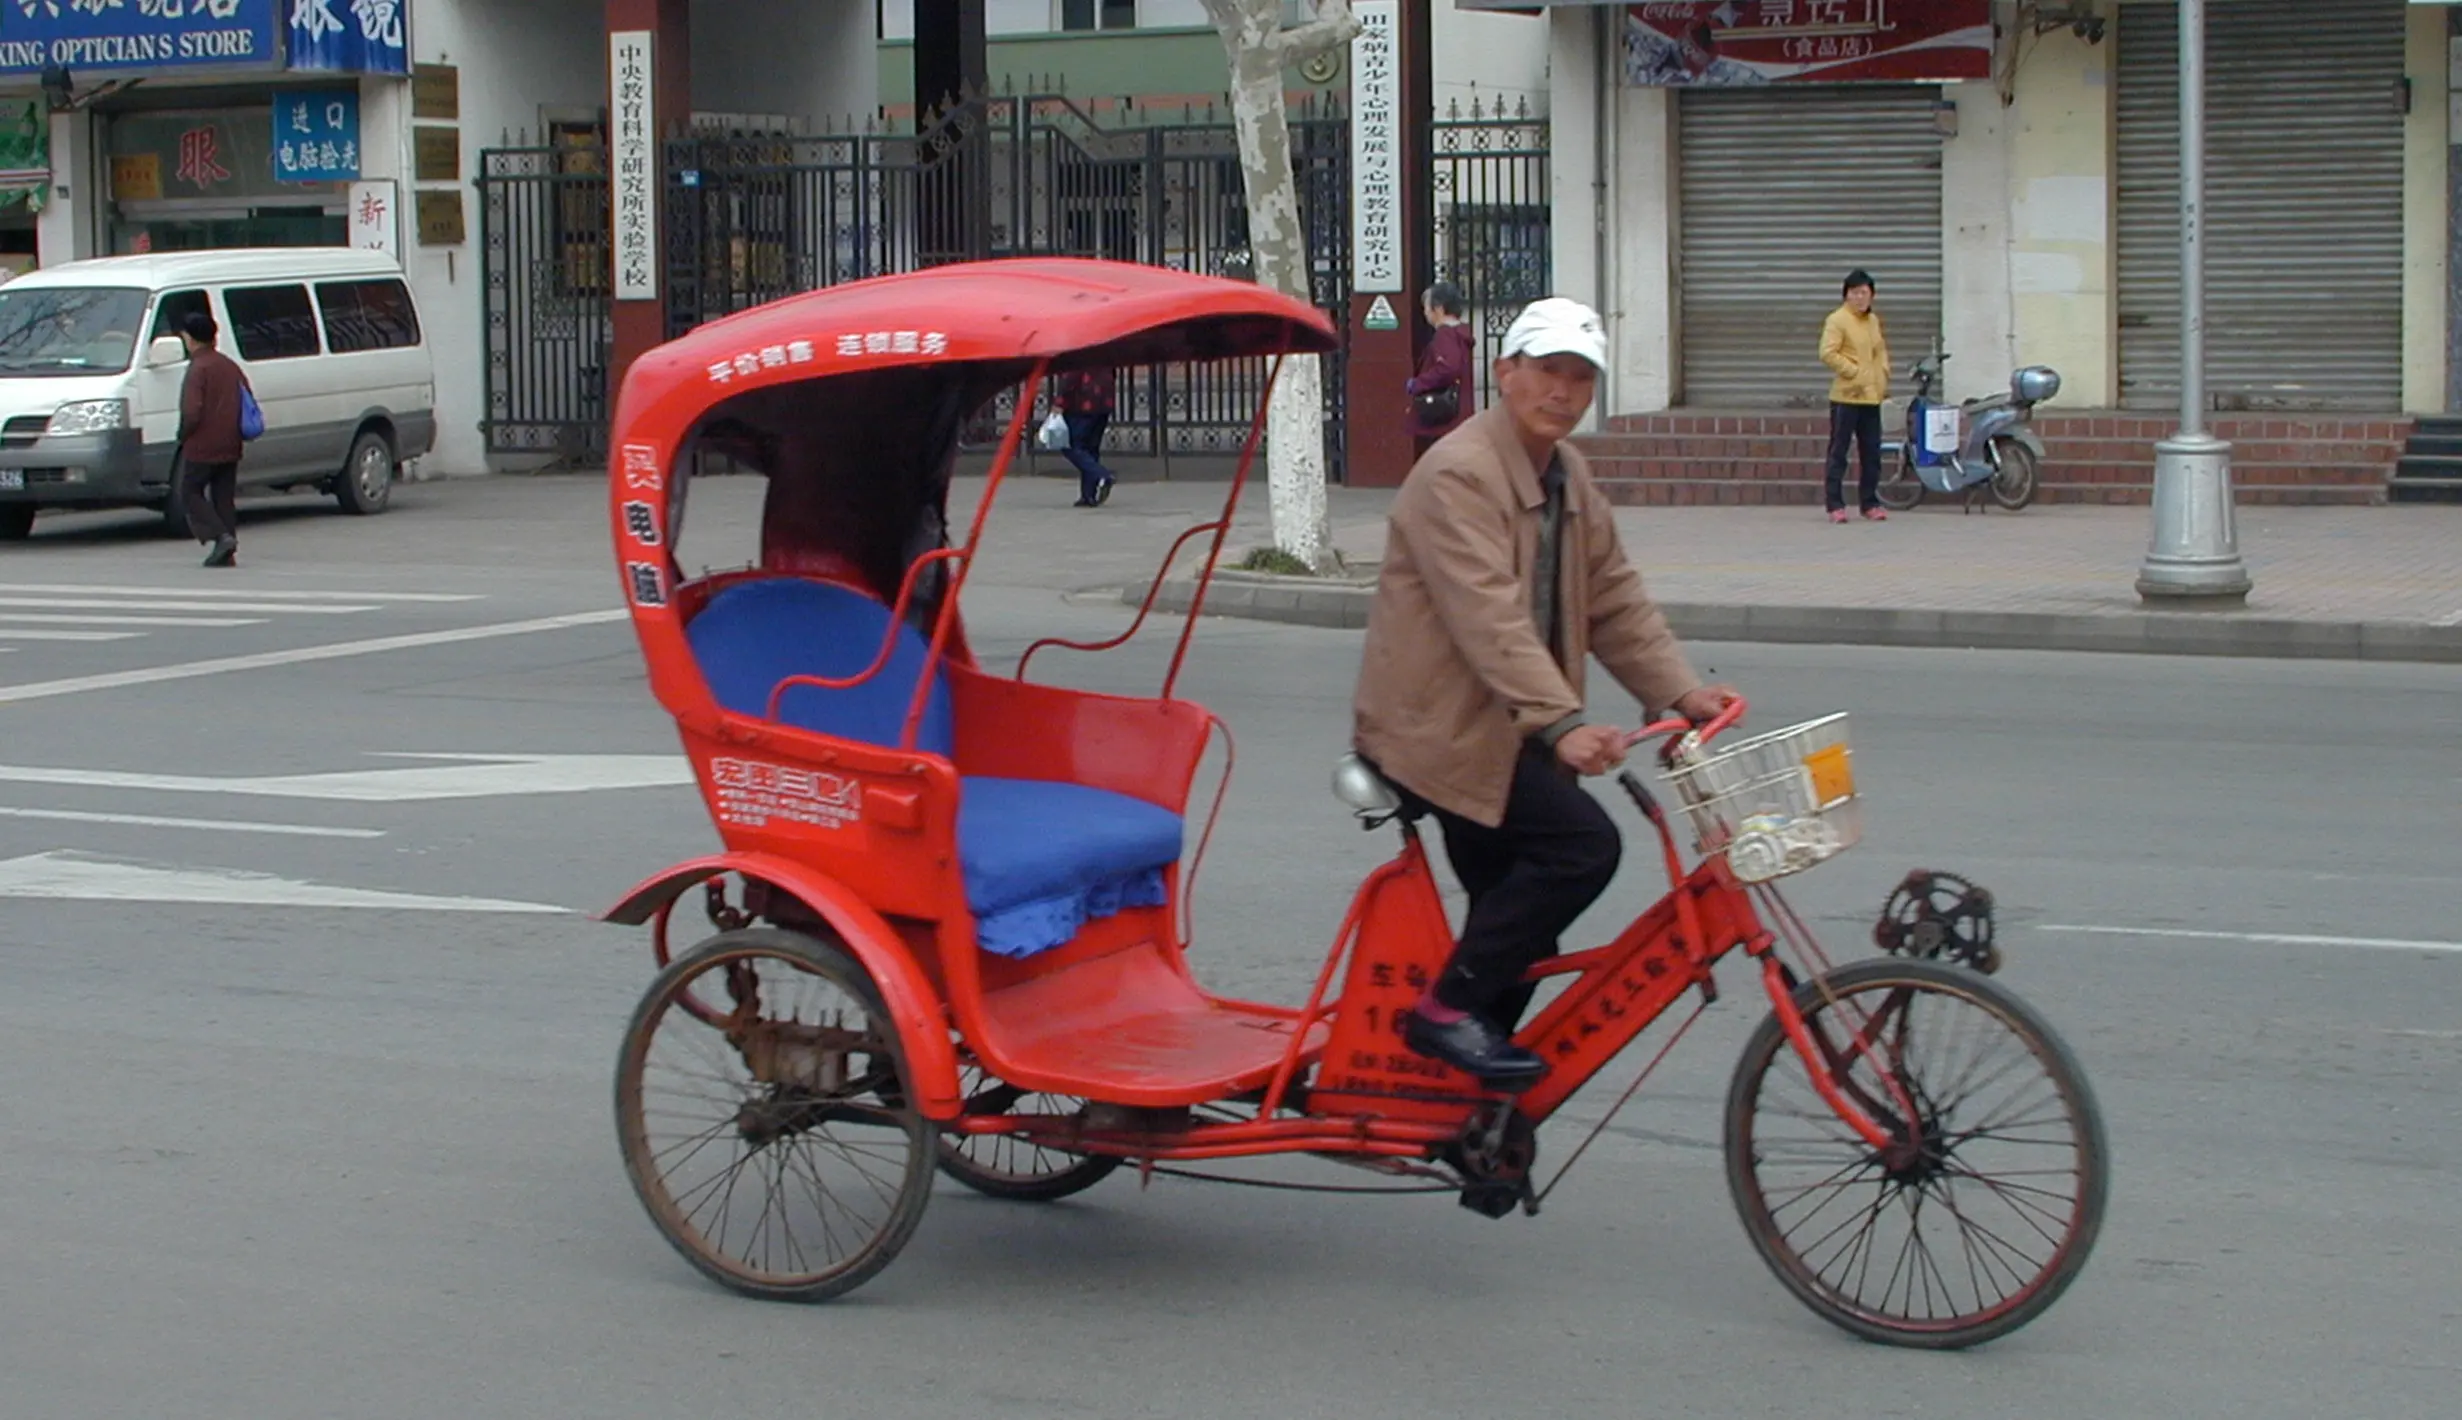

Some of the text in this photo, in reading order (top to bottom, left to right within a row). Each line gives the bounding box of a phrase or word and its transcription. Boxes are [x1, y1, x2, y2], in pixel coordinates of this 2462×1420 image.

[51, 34, 173, 65] OPTICIANS
[179, 29, 254, 59] STORE
[291, 101, 345, 133] 进口
[176, 123, 231, 190] 眼
[279, 139, 358, 172] 电脑验光
[619, 43, 648, 287] 中央教育科学研究所实验学校
[357, 191, 386, 249] 新
